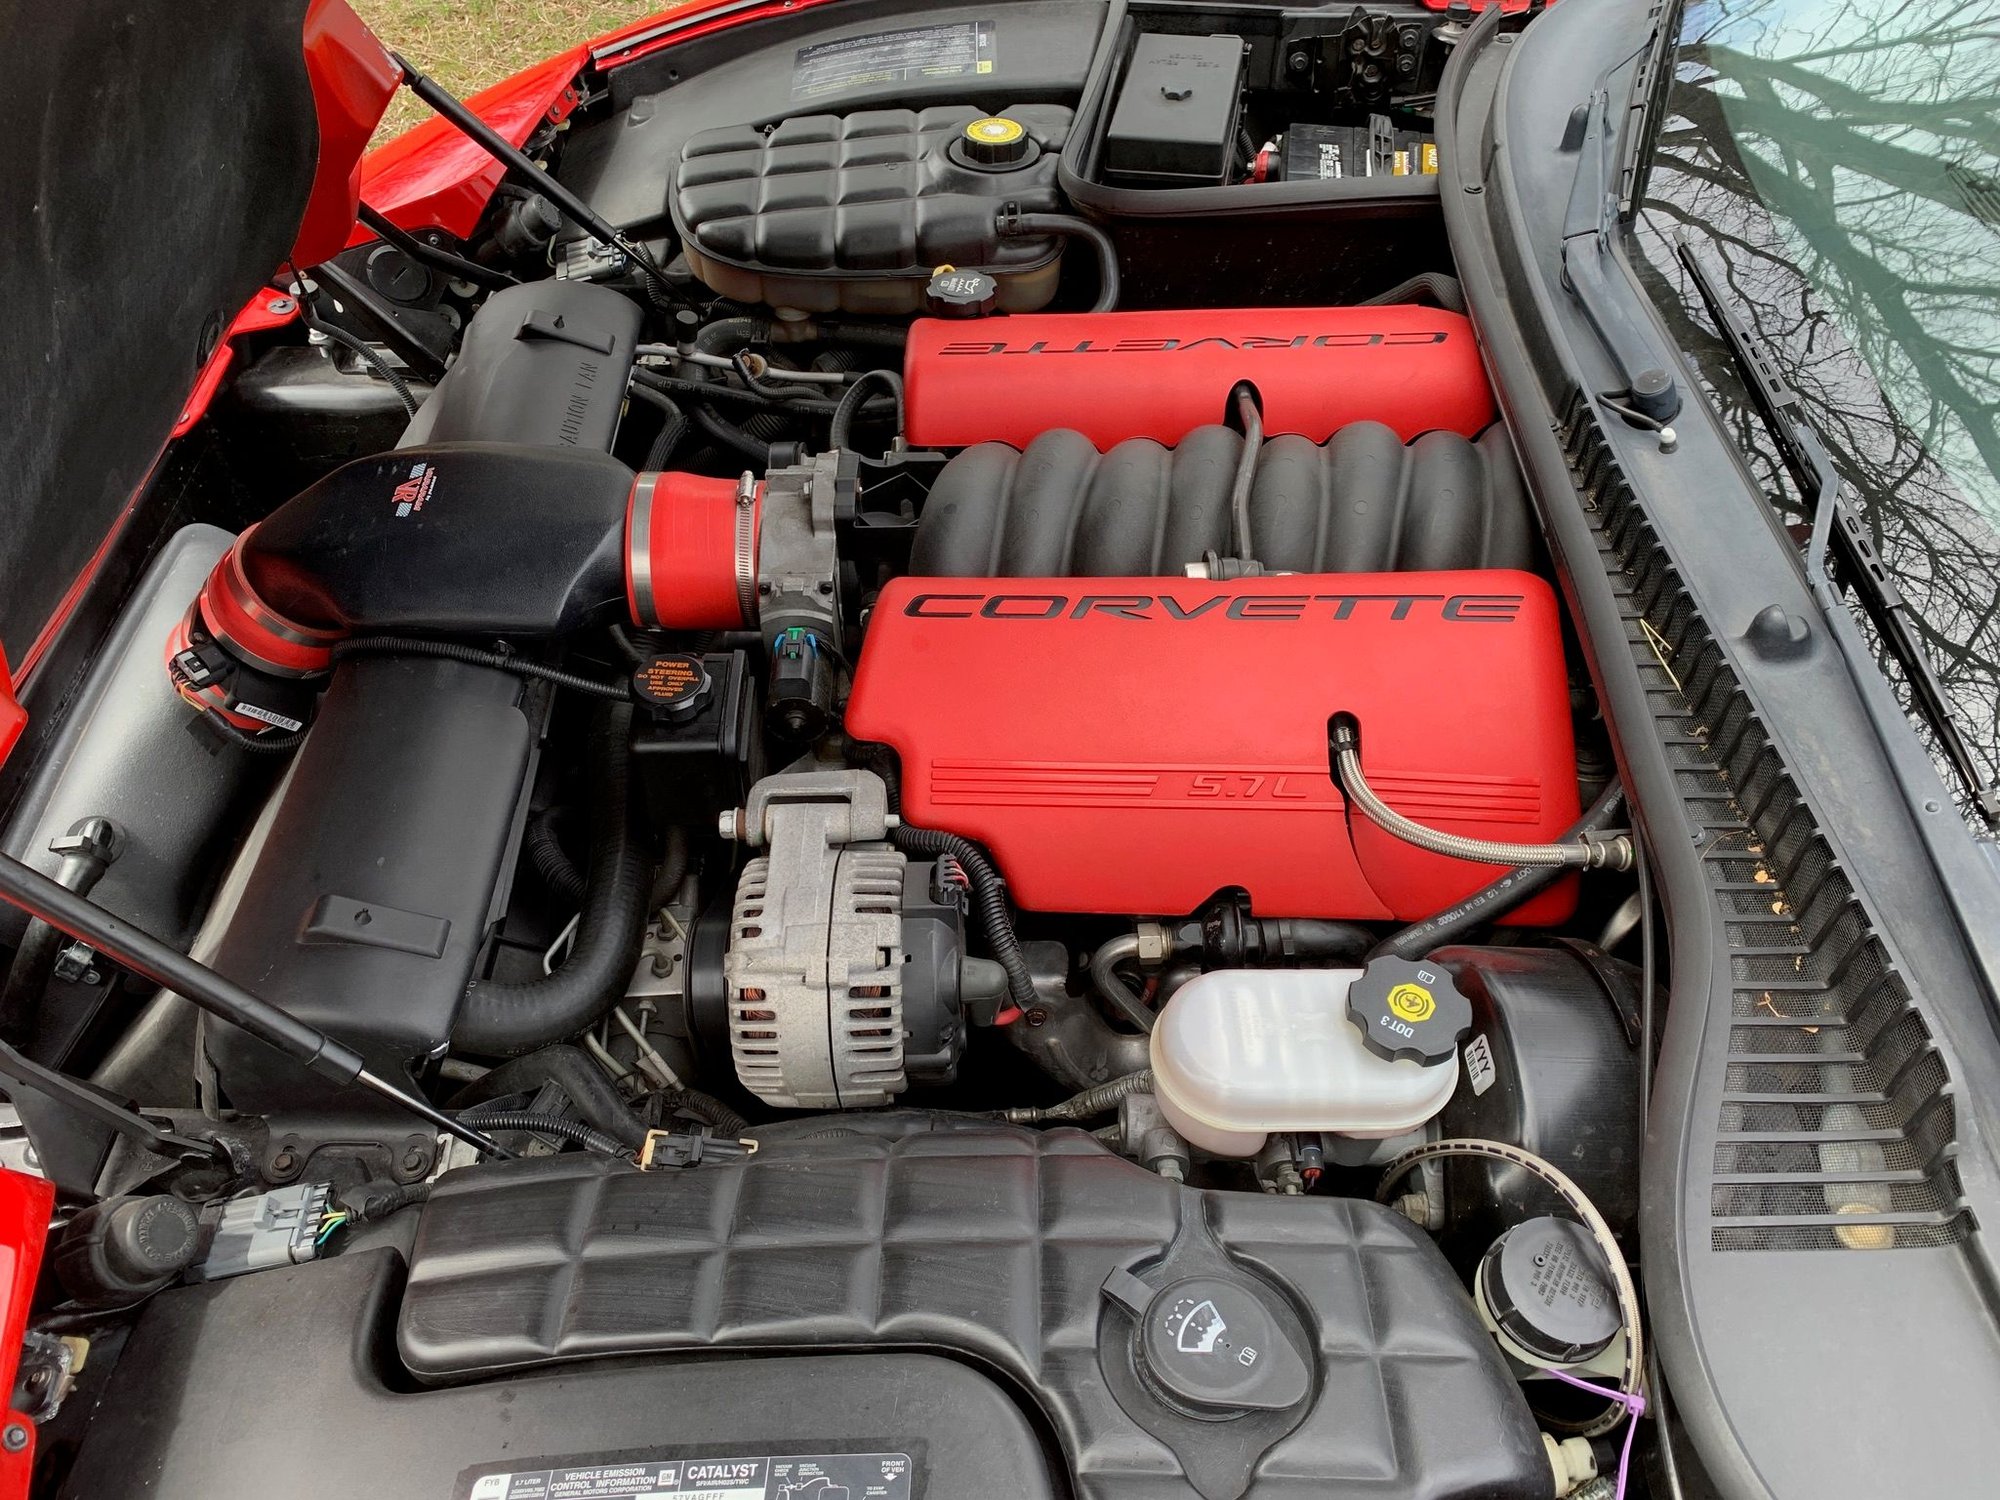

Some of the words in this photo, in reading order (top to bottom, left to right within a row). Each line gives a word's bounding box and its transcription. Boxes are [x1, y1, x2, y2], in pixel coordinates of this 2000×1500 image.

[938, 332, 1449, 356] CORVETTE
[904, 594, 1524, 622] CORVETTE
[648, 668, 693, 676] STEERING
[1188, 775, 1306, 798] 5.7L
[1380, 1016, 1388, 1026] 3
[1389, 1021, 1414, 1038] DOT
[1474, 1038, 1490, 1074] YYY
[565, 1471, 602, 1481] VEHICLE
[603, 1468, 646, 1479] EMISSION
[687, 1463, 759, 1479] CATALYST
[551, 1481, 592, 1492] CONTROL
[596, 1476, 656, 1490] INFORMATION
[609, 1485, 652, 1494] CORPORATION
